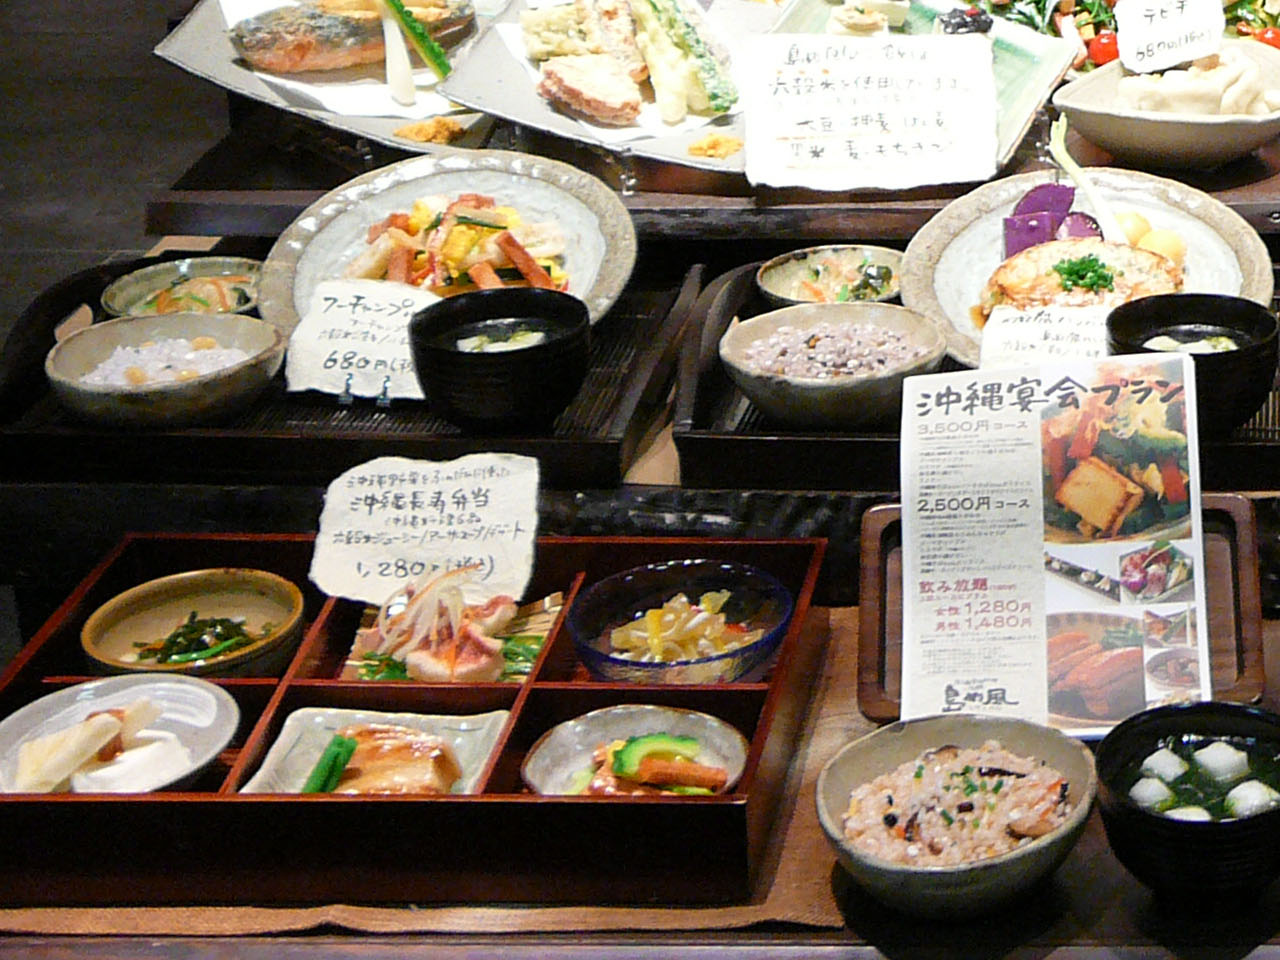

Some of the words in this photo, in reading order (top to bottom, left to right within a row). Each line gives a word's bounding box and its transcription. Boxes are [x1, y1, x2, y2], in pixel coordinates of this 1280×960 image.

[1143, 0, 1188, 25] テビチ
[916, 375, 1184, 417] 沖縄宴会プラン
[917, 419, 1028, 435] 3,500円コース
[350, 487, 491, 516] 沖縄長寿弁当
[917, 496, 1031, 513] 2,500円コース
[918, 577, 989, 595] 飲み放題
